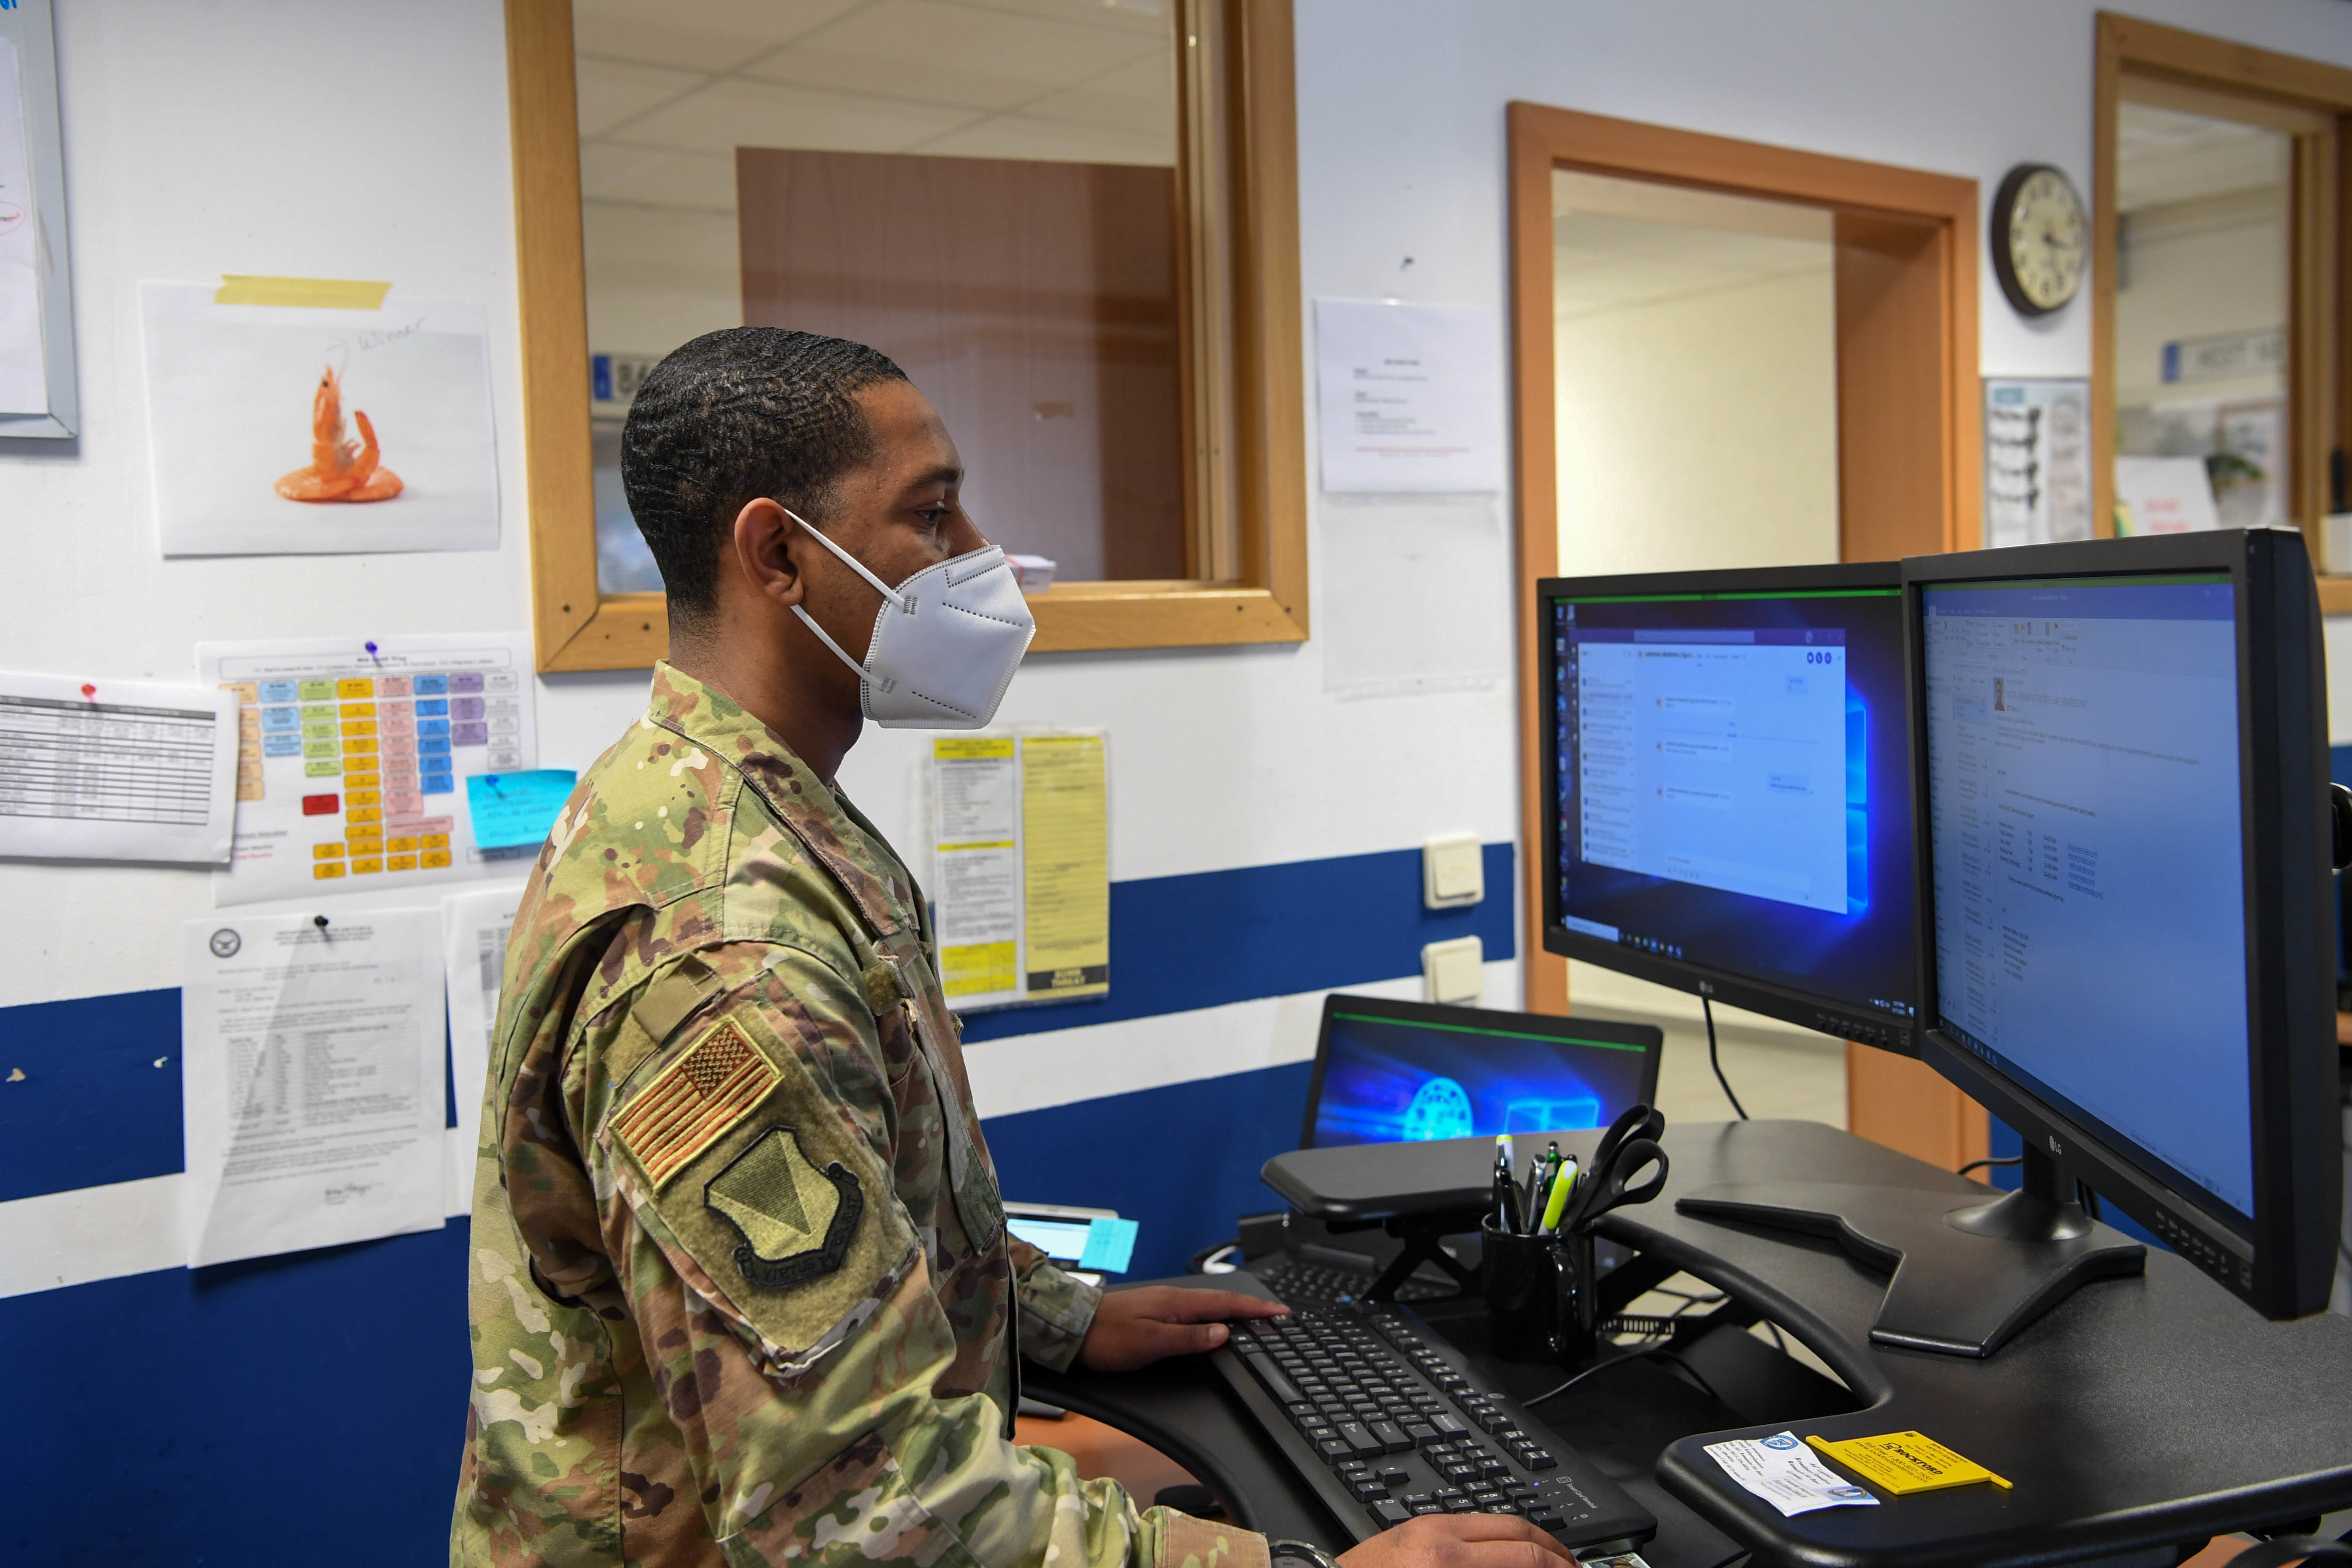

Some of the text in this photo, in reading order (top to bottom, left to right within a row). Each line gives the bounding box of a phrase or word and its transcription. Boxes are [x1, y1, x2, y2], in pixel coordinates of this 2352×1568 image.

[1863, 1442, 1891, 1455] Toll-Free
[1892, 1448, 1945, 1475] ROCKFORD
[1924, 1445, 1944, 1454] SAFETY
[1853, 1441, 1930, 1483] www.rockfordsystems.com
[1566, 1483, 1598, 1509] Smart Card Terminal
